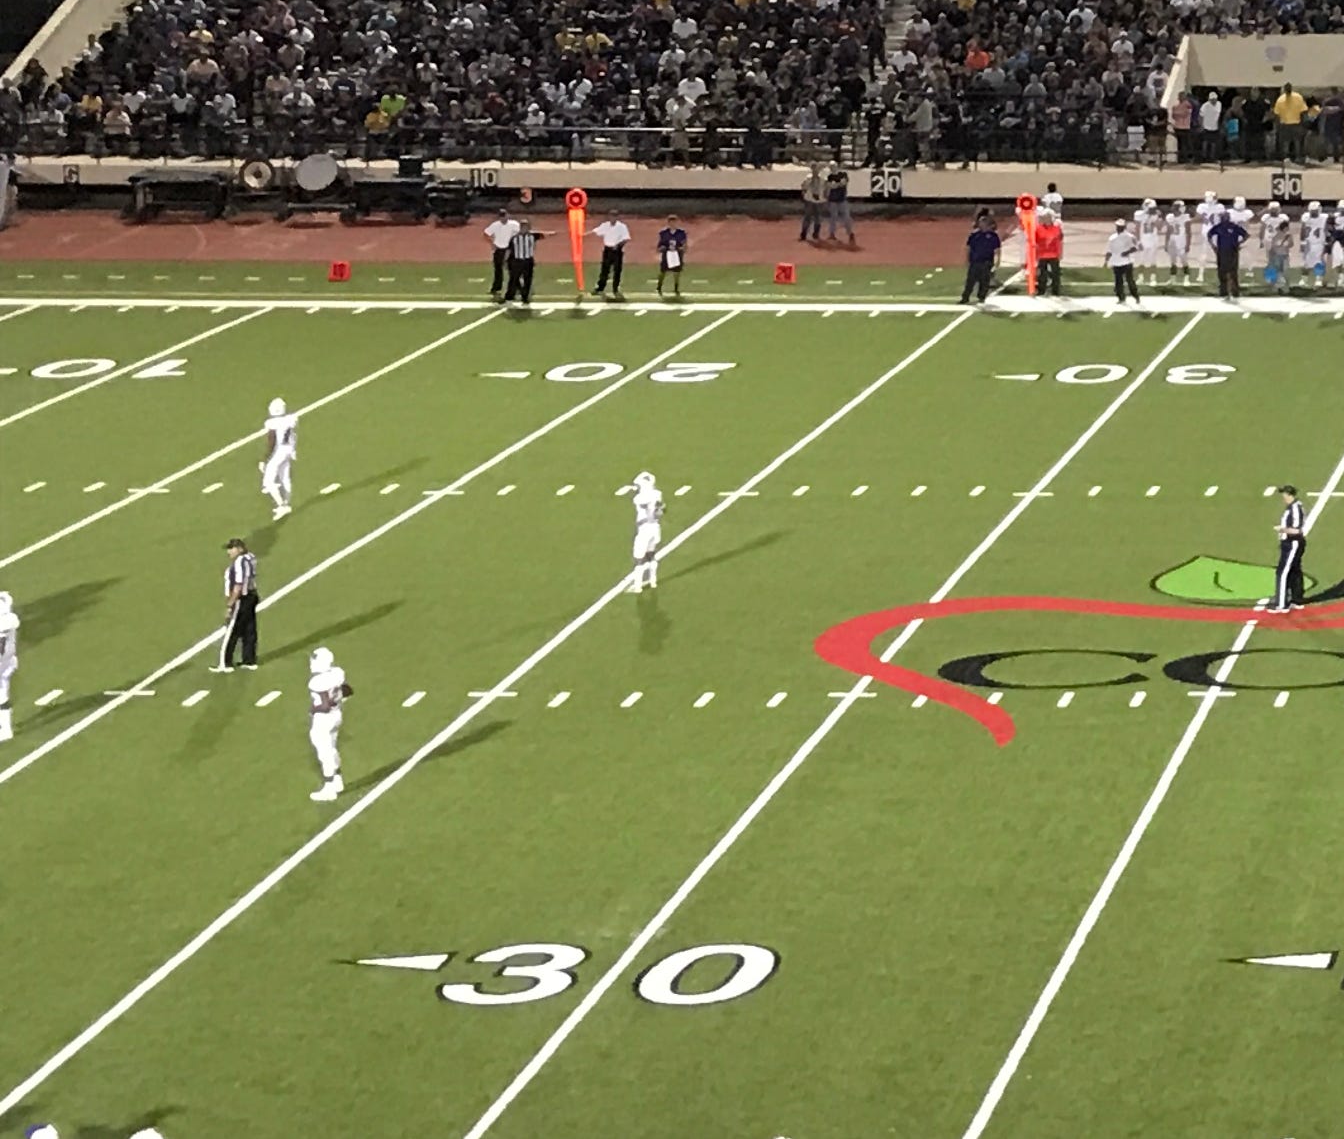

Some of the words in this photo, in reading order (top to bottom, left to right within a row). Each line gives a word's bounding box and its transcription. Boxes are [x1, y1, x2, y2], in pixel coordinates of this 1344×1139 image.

[473, 169, 497, 188] 10
[872, 175, 901, 194] 20
[1272, 177, 1302, 196] 30
[437, 942, 781, 1005] 30
